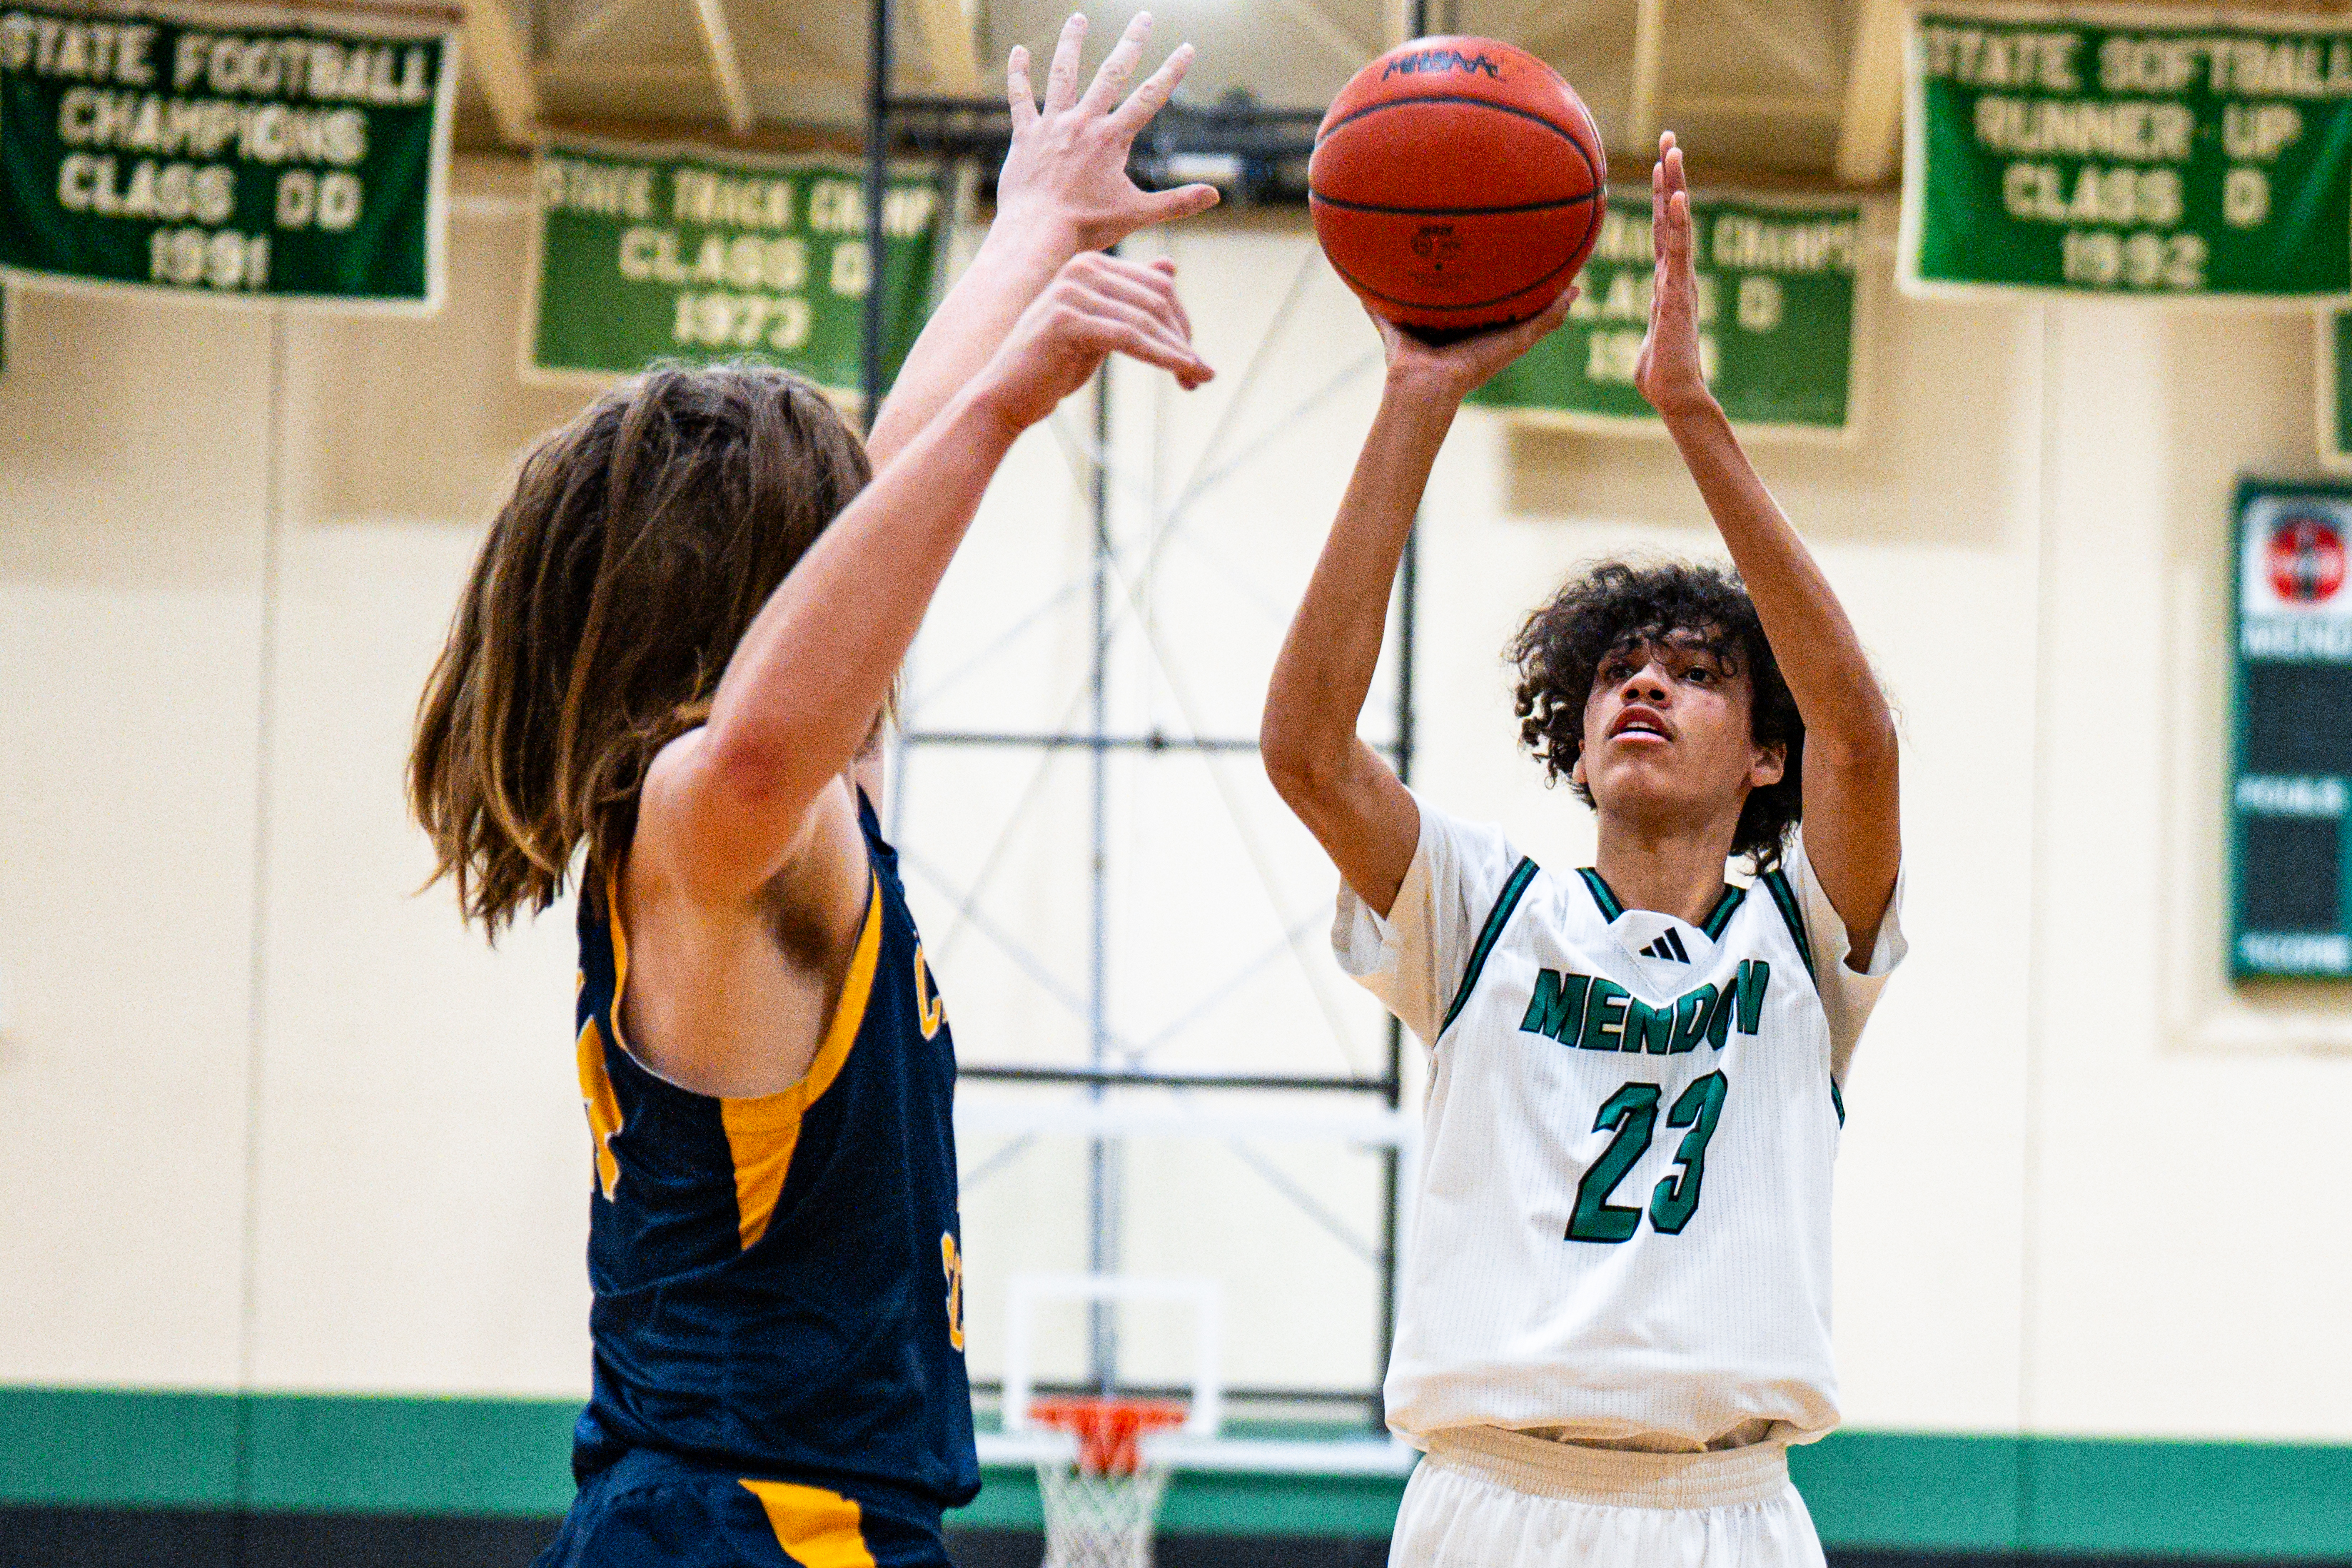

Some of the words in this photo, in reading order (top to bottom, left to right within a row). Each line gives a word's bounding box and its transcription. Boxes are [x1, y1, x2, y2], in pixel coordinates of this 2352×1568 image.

[0, 11, 158, 84] STATE
[172, 33, 432, 105] FOOTBALL
[1924, 27, 2081, 91] STATE
[58, 85, 367, 164] CHAMPIONS
[1974, 96, 2195, 161] RUNNER
[2221, 102, 2303, 162] UP
[56, 151, 236, 223] CLASS
[538, 161, 652, 215] STATE
[810, 178, 936, 238] CHMP
[2002, 162, 2184, 225] CLASS
[2222, 167, 2271, 229] D
[619, 226, 808, 291] CLASS
[1519, 958, 1771, 1056] MENDON
[1564, 1068, 1728, 1243] 23
